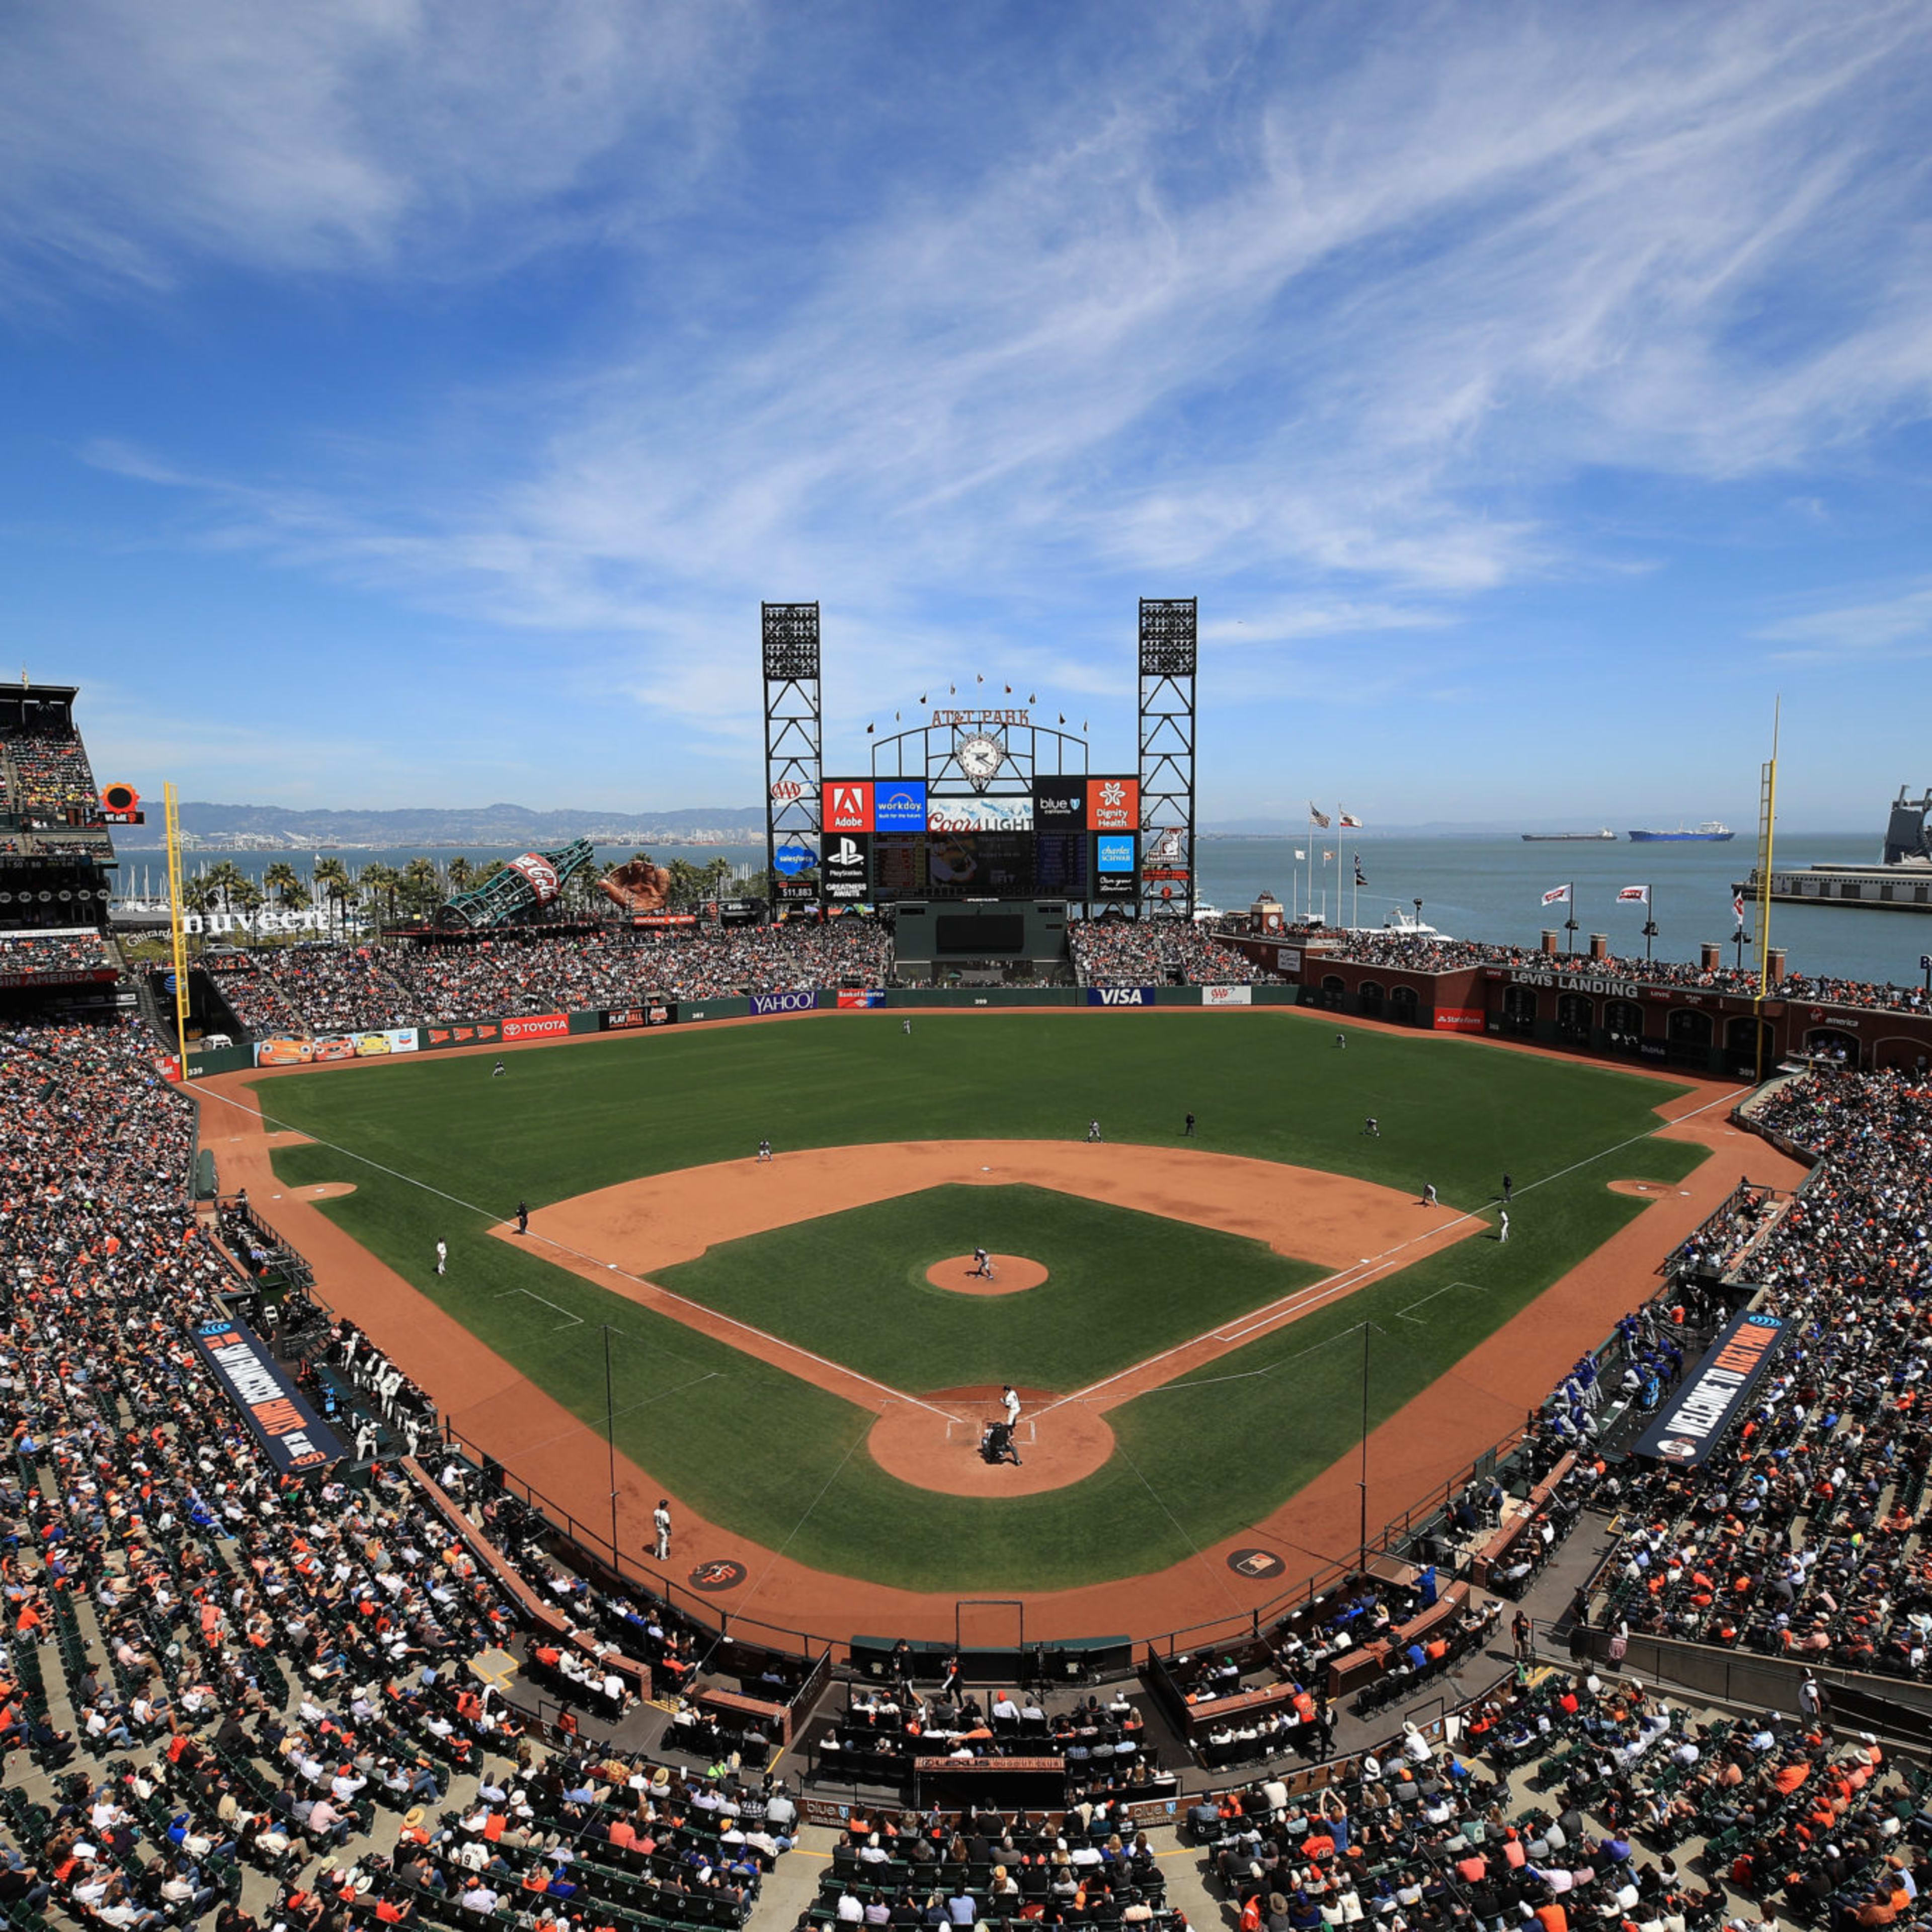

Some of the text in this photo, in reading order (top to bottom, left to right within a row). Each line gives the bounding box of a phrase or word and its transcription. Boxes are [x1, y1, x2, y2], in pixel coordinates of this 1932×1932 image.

[932, 709, 1029, 728] AT&T PARK
[773, 782, 800, 798] AAA
[1040, 798, 1067, 809] blue
[835, 817, 862, 826] Adobe
[1096, 809, 1128, 819] Dignity
[928, 813, 1033, 831] Coors LIGHT
[1098, 819, 1127, 827] Health
[25, 972, 95, 986] AMERICA
[1557, 977, 1638, 998] LANDING
[754, 992, 815, 1014] YAHOO!
[1098, 989, 1143, 1004] VISA
[522, 1020, 567, 1032] TOYOTA
[609, 1015, 625, 1024] PLAY
[1825, 1017, 1859, 1027] america
[188, 1067, 203, 1076] 339
[1729, 1323, 1779, 1350] PARK
[211, 1343, 254, 1363] SAN
[1713, 1344, 1762, 1374] AT&T
[222, 1357, 285, 1405] FRANCISCO
[1701, 1368, 1746, 1386] TO
[1665, 1380, 1738, 1438] WELCOME
[250, 1398, 307, 1436] GIANTS
[807, 1801, 835, 1816] blue
[1135, 1805, 1163, 1817] blue
[464, 1854, 471, 1866] 9
[1317, 1848, 1331, 1859] 40
